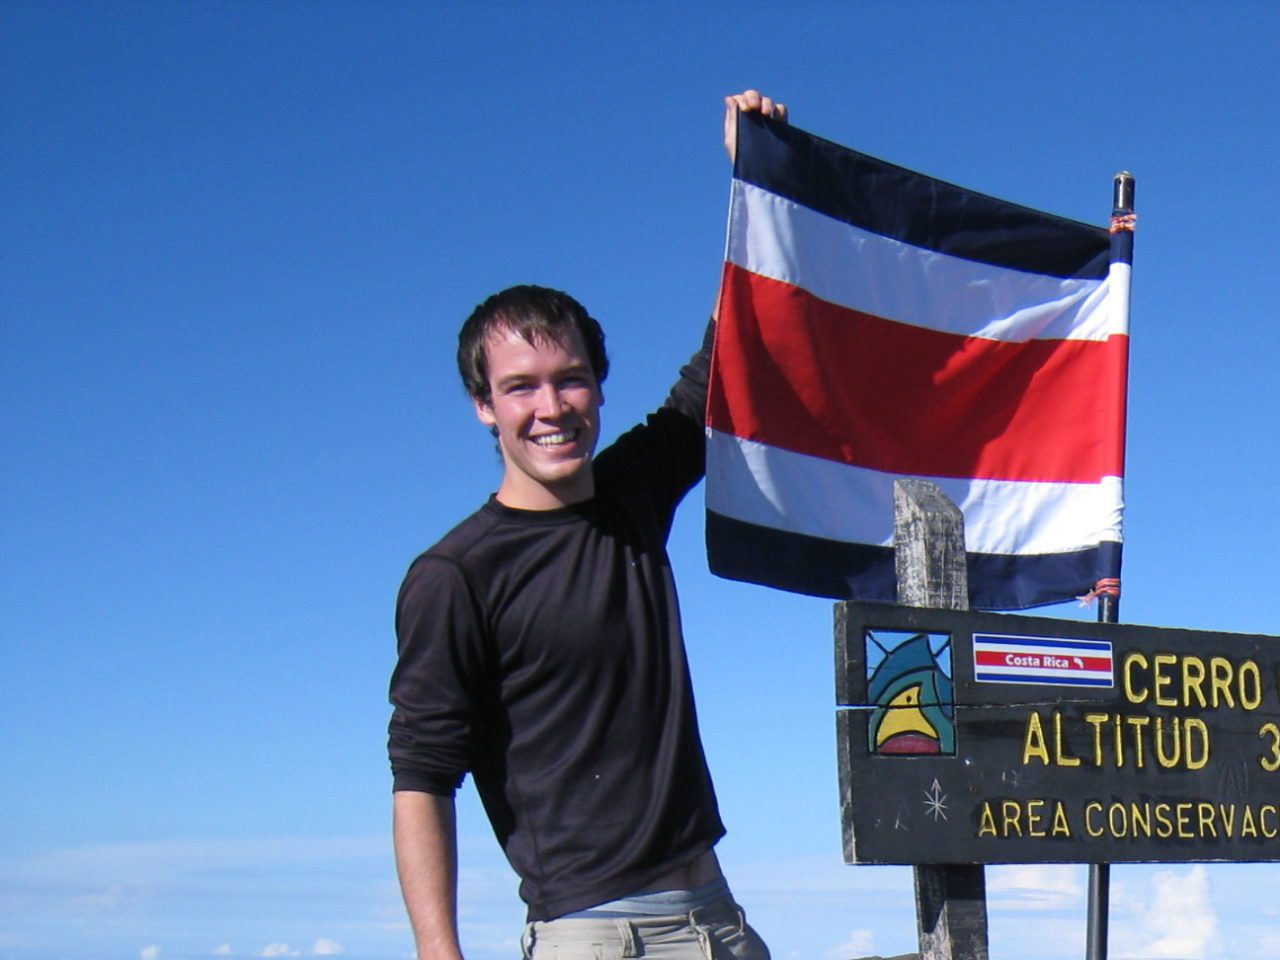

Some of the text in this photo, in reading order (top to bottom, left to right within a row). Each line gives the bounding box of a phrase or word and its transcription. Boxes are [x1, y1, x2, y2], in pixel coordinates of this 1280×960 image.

[1004, 654, 1069, 669] Costa Rica
[1124, 653, 1262, 711] CERRO
[1022, 711, 1210, 770] ALTITUD
[978, 800, 1071, 838] AREA
